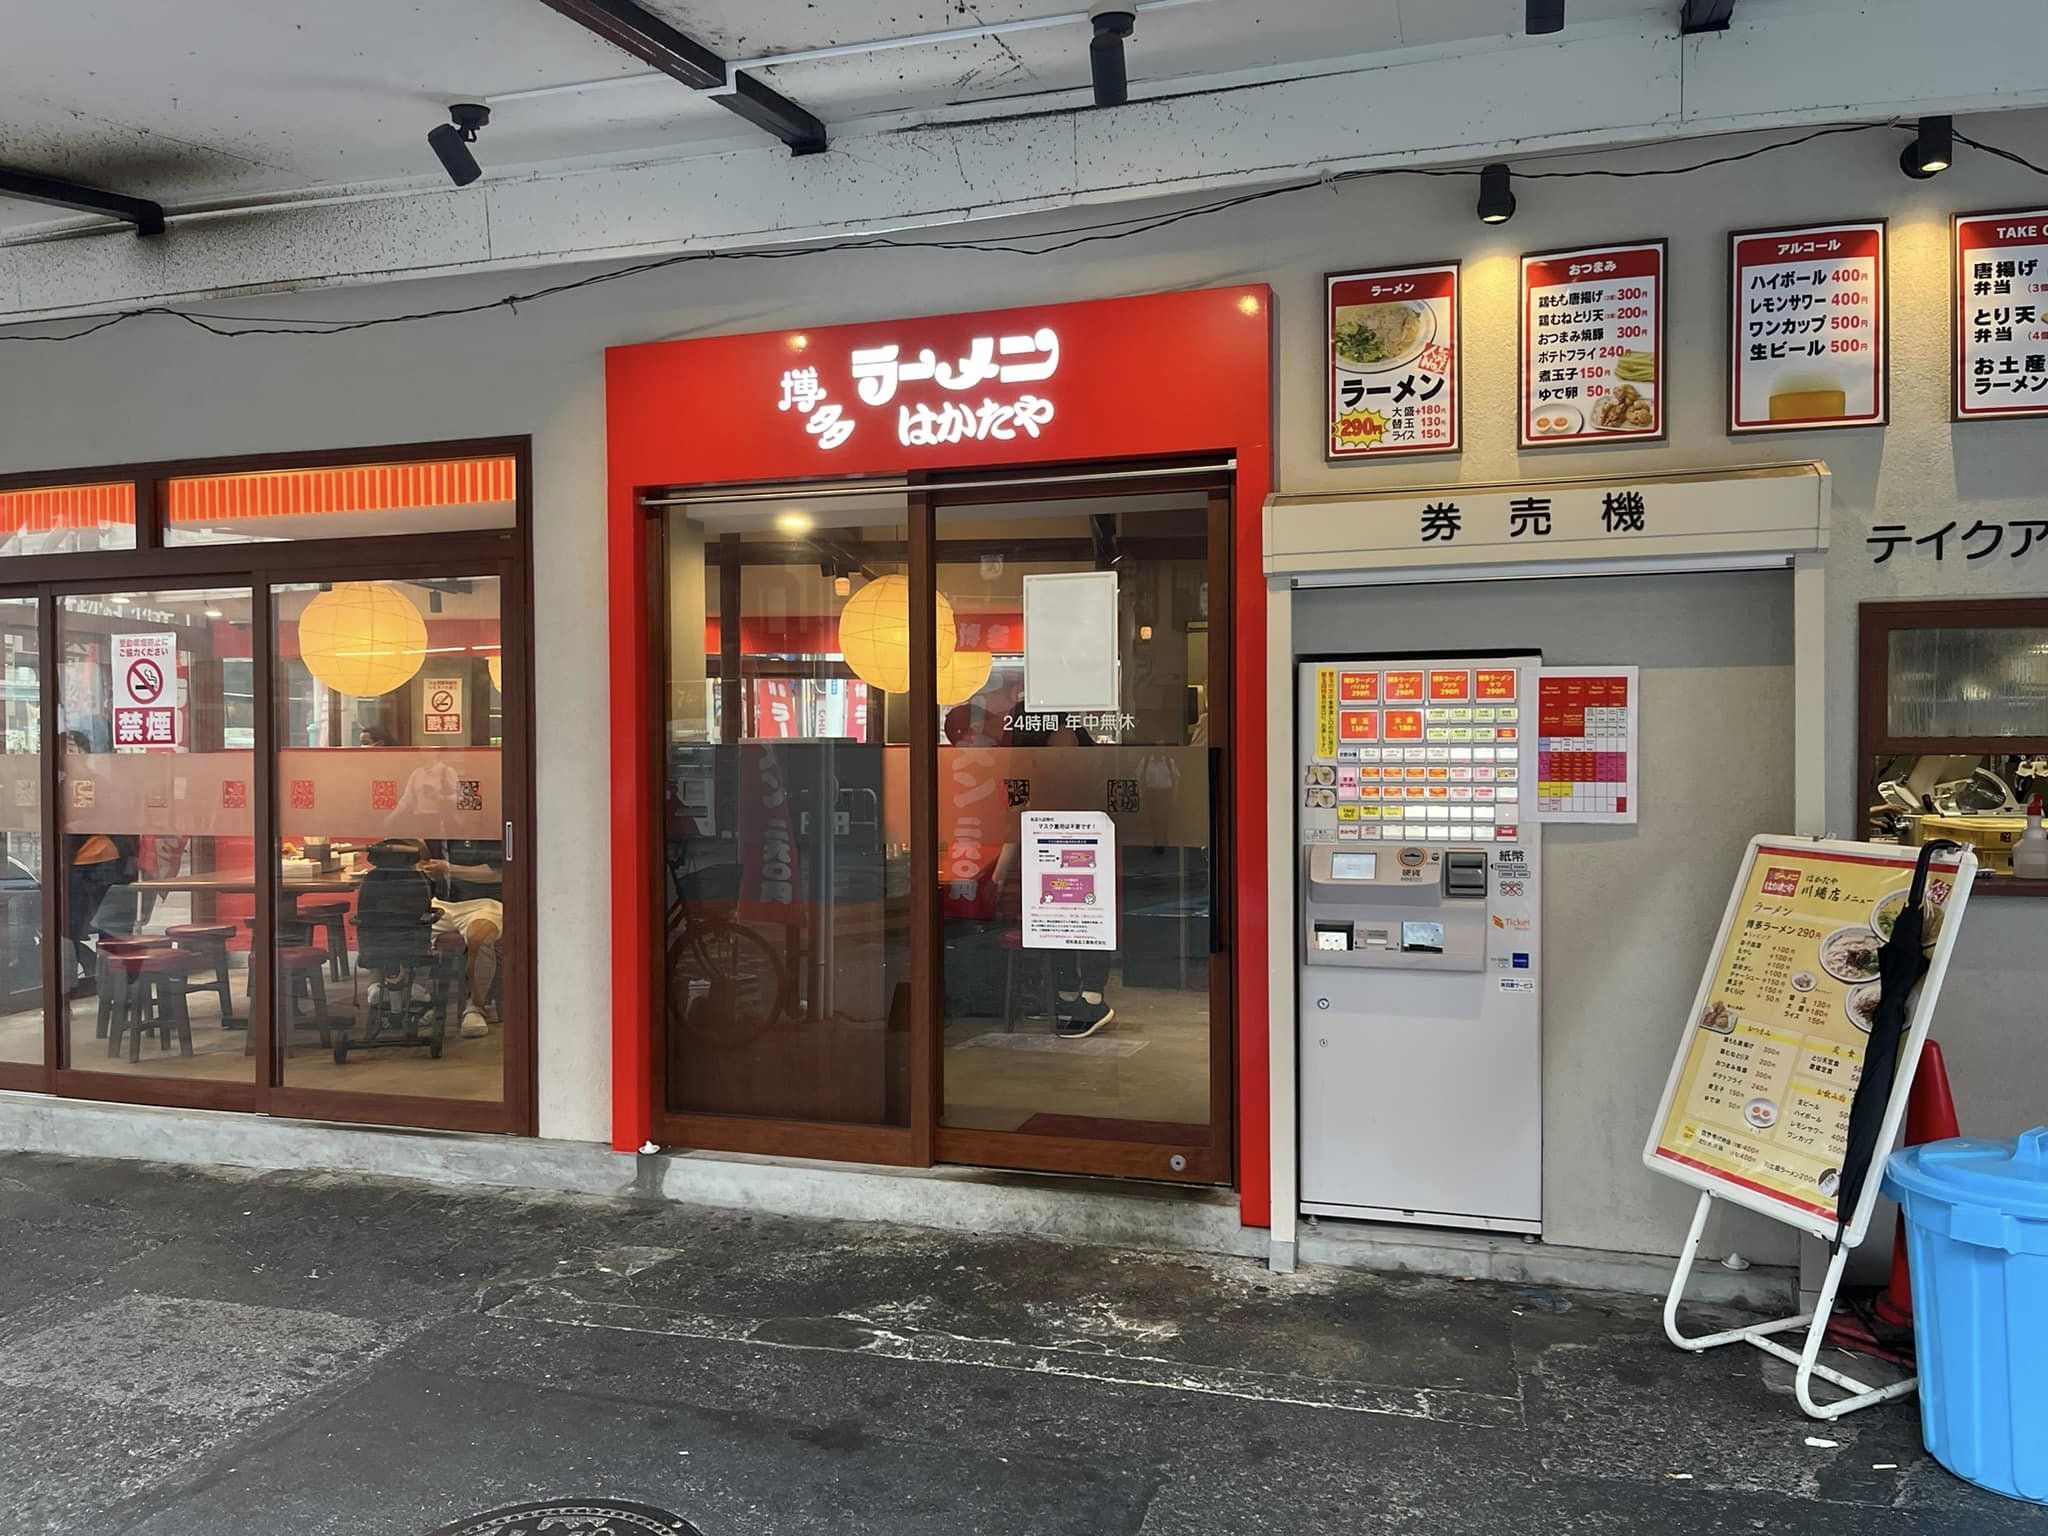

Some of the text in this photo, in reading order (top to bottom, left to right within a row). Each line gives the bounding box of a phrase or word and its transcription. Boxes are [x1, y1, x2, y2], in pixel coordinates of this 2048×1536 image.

[1996, 226, 2037, 239] TAKE
[1778, 239, 1841, 256] アルコール
[1569, 262, 1617, 277] おつまみ
[1974, 259, 2038, 280] 唐揚げ
[1750, 268, 1868, 291] ハイボール 400円
[1974, 279, 2011, 296] 弁当
[1371, 282, 1415, 297] ラーメン
[1617, 288, 1648, 301] 300円
[1750, 292, 1868, 315] レモンサワー 400円
[1617, 307, 1648, 320] 200円
[1974, 305, 2035, 326] とり天
[1617, 326, 1648, 339] 300円
[1749, 315, 1868, 338] ワンカップ 500円
[1974, 327, 2013, 343] 弁当
[1538, 347, 1596, 365] ポテトフライ
[1749, 339, 1868, 361] 生ビール 500円
[851, 327, 1060, 407] ラーメン
[1538, 366, 1611, 383] 煮玉子 150円
[1974, 355, 2046, 376] お土産
[1341, 374, 1445, 408] ラーメン
[1538, 384, 1611, 402] ゆで卵 50円
[1974, 375, 2048, 397] ラーメン
[778, 366, 856, 450] 博多
[1392, 407, 1414, 418] 大盛
[898, 395, 1055, 447] はかたや
[1340, 417, 1382, 437] 290円
[1392, 418, 1414, 429] 替玉
[1392, 430, 1415, 441] ライス
[1420, 491, 1646, 542] 券売機
[118, 711, 172, 742] 禁煙
[1003, 712, 1136, 732] 24時間 年中無休
[1499, 850, 1525, 862] 紙幣
[1754, 902, 1793, 917] ラーメン
[1746, 918, 1822, 940] 博多ラーメン 290円
